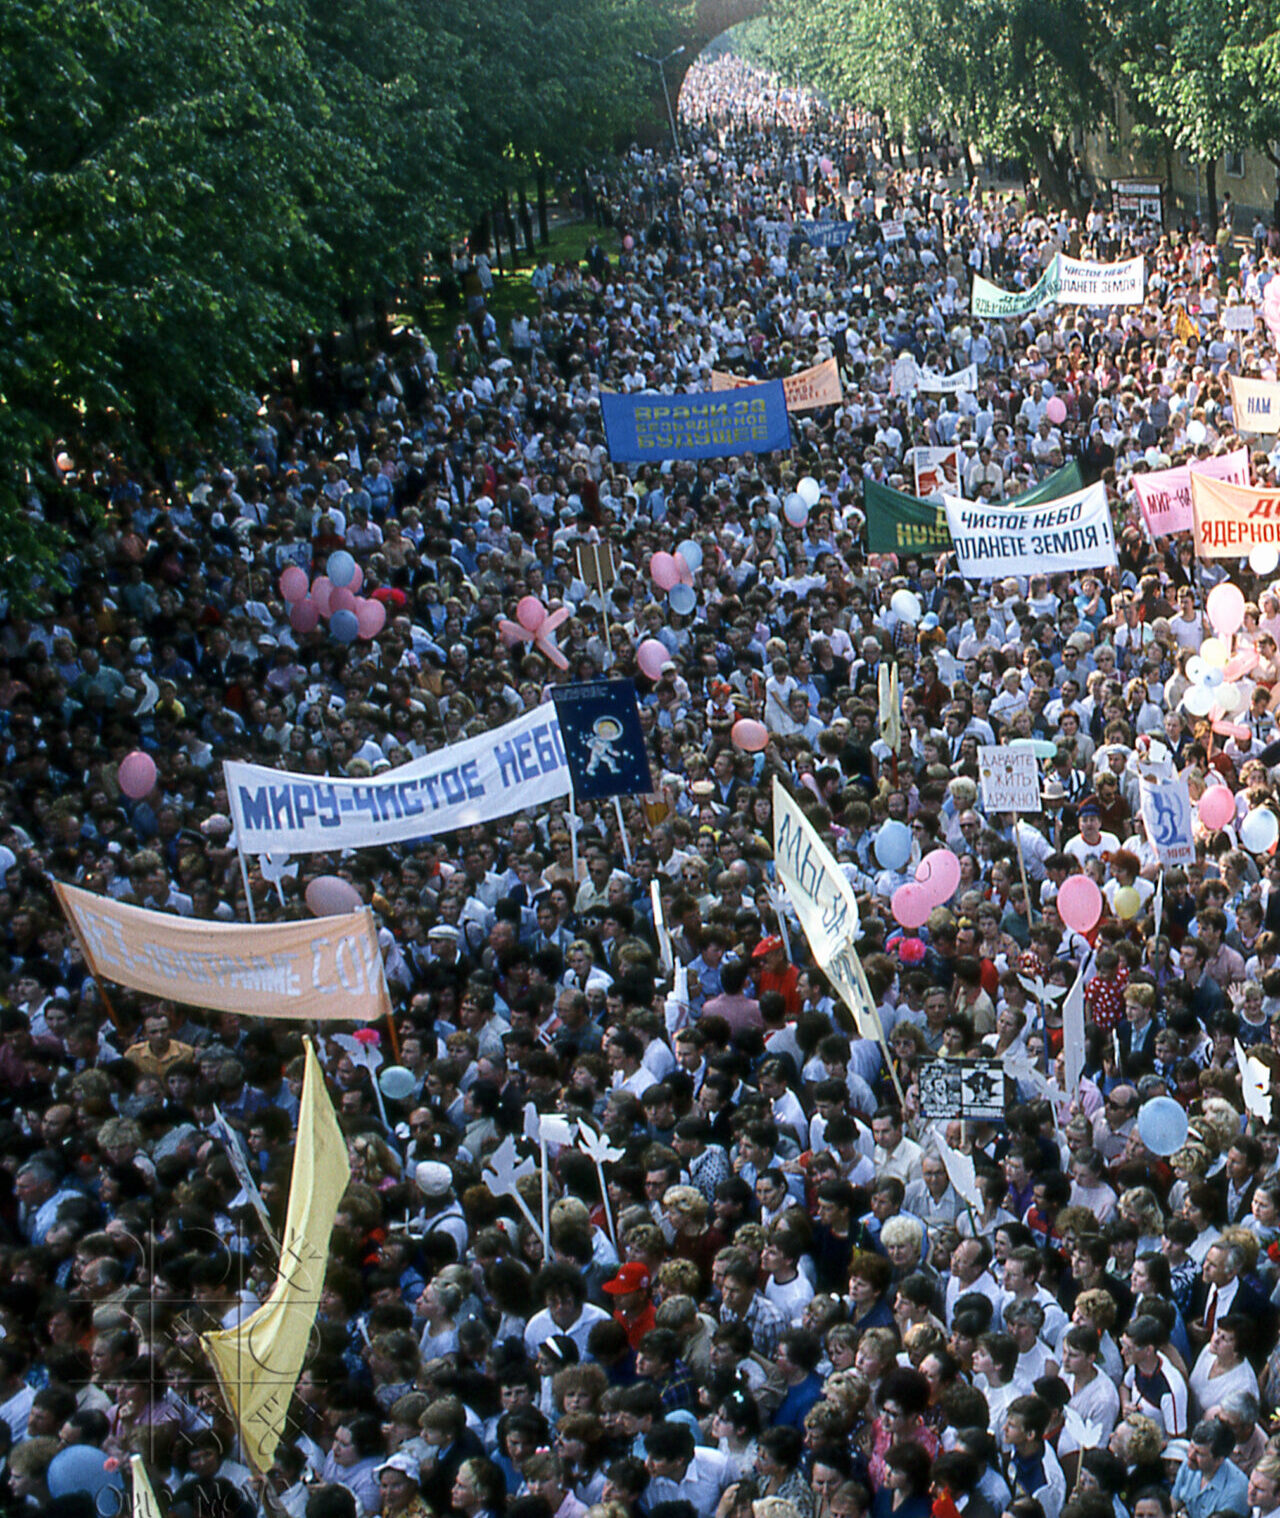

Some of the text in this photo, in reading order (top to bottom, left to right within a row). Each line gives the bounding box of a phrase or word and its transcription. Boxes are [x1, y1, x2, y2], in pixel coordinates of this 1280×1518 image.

[1101, 278, 1136, 293] ЗЕМЛЯ
[635, 398, 767, 423] ВРАЧИ ЗА
[1247, 397, 1271, 415] НАМ
[638, 425, 768, 450] БУДУЩЕЕ
[961, 510, 1030, 531] ЧИСТОЕ
[1033, 502, 1084, 529] НЕБО
[896, 522, 950, 548] НУЖ
[953, 536, 1028, 561] ПЛАНЕТЕ
[1031, 525, 1099, 555] ЗЕМЛЯ
[981, 753, 1035, 768] ДАВАЙТЕ
[996, 772, 1033, 787] ЖИТЬ
[985, 786, 1040, 808] ДРУЖНО!
[778, 813, 826, 905] МЫ
